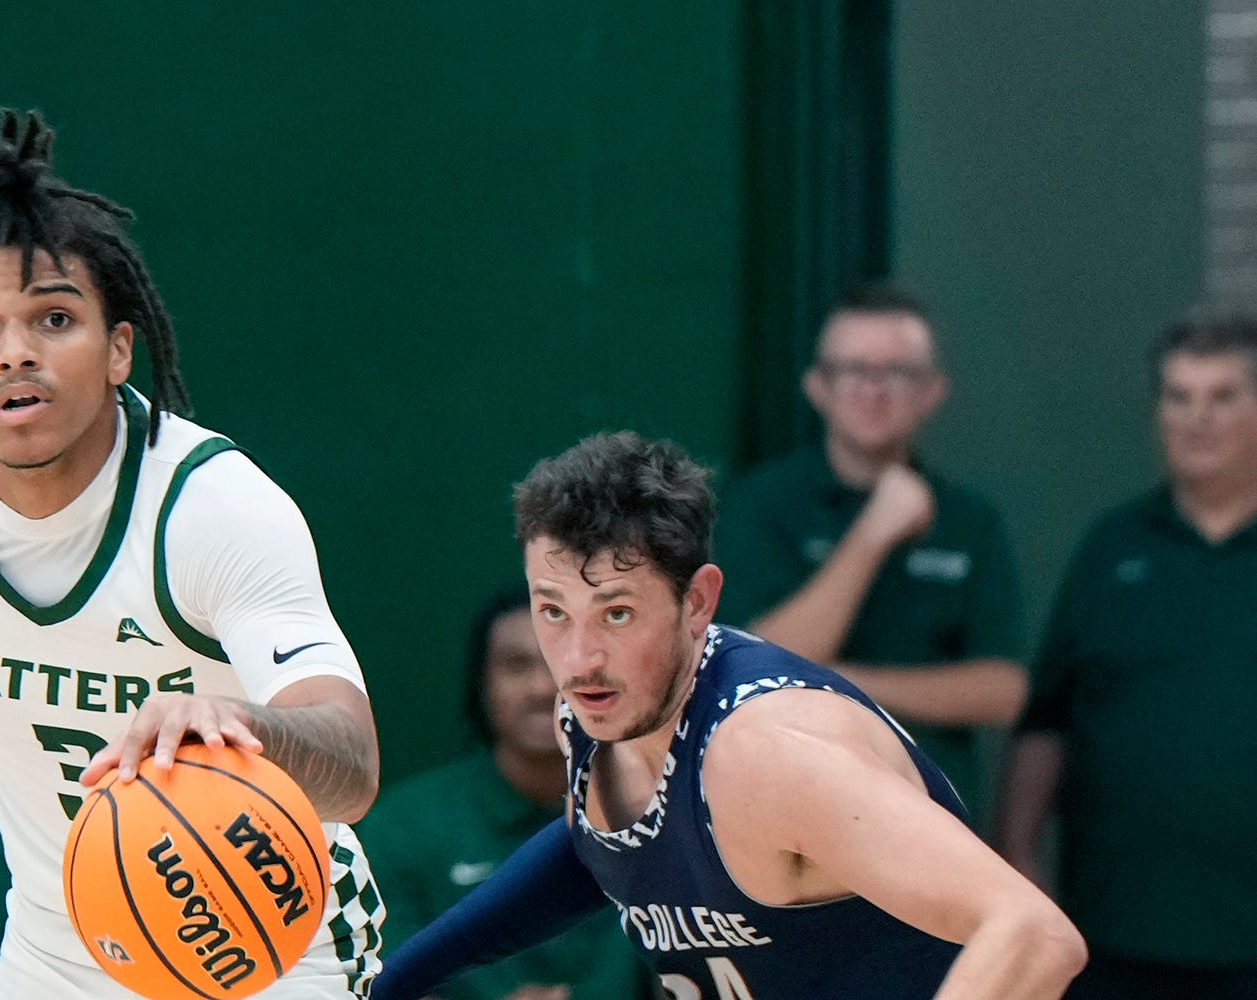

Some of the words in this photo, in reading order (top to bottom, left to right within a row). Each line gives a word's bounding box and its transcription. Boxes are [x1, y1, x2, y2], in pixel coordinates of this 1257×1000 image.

[147, 834, 257, 991] Wilson
[223, 810, 310, 927] NCAA
[629, 903, 773, 952] COLLEGE
